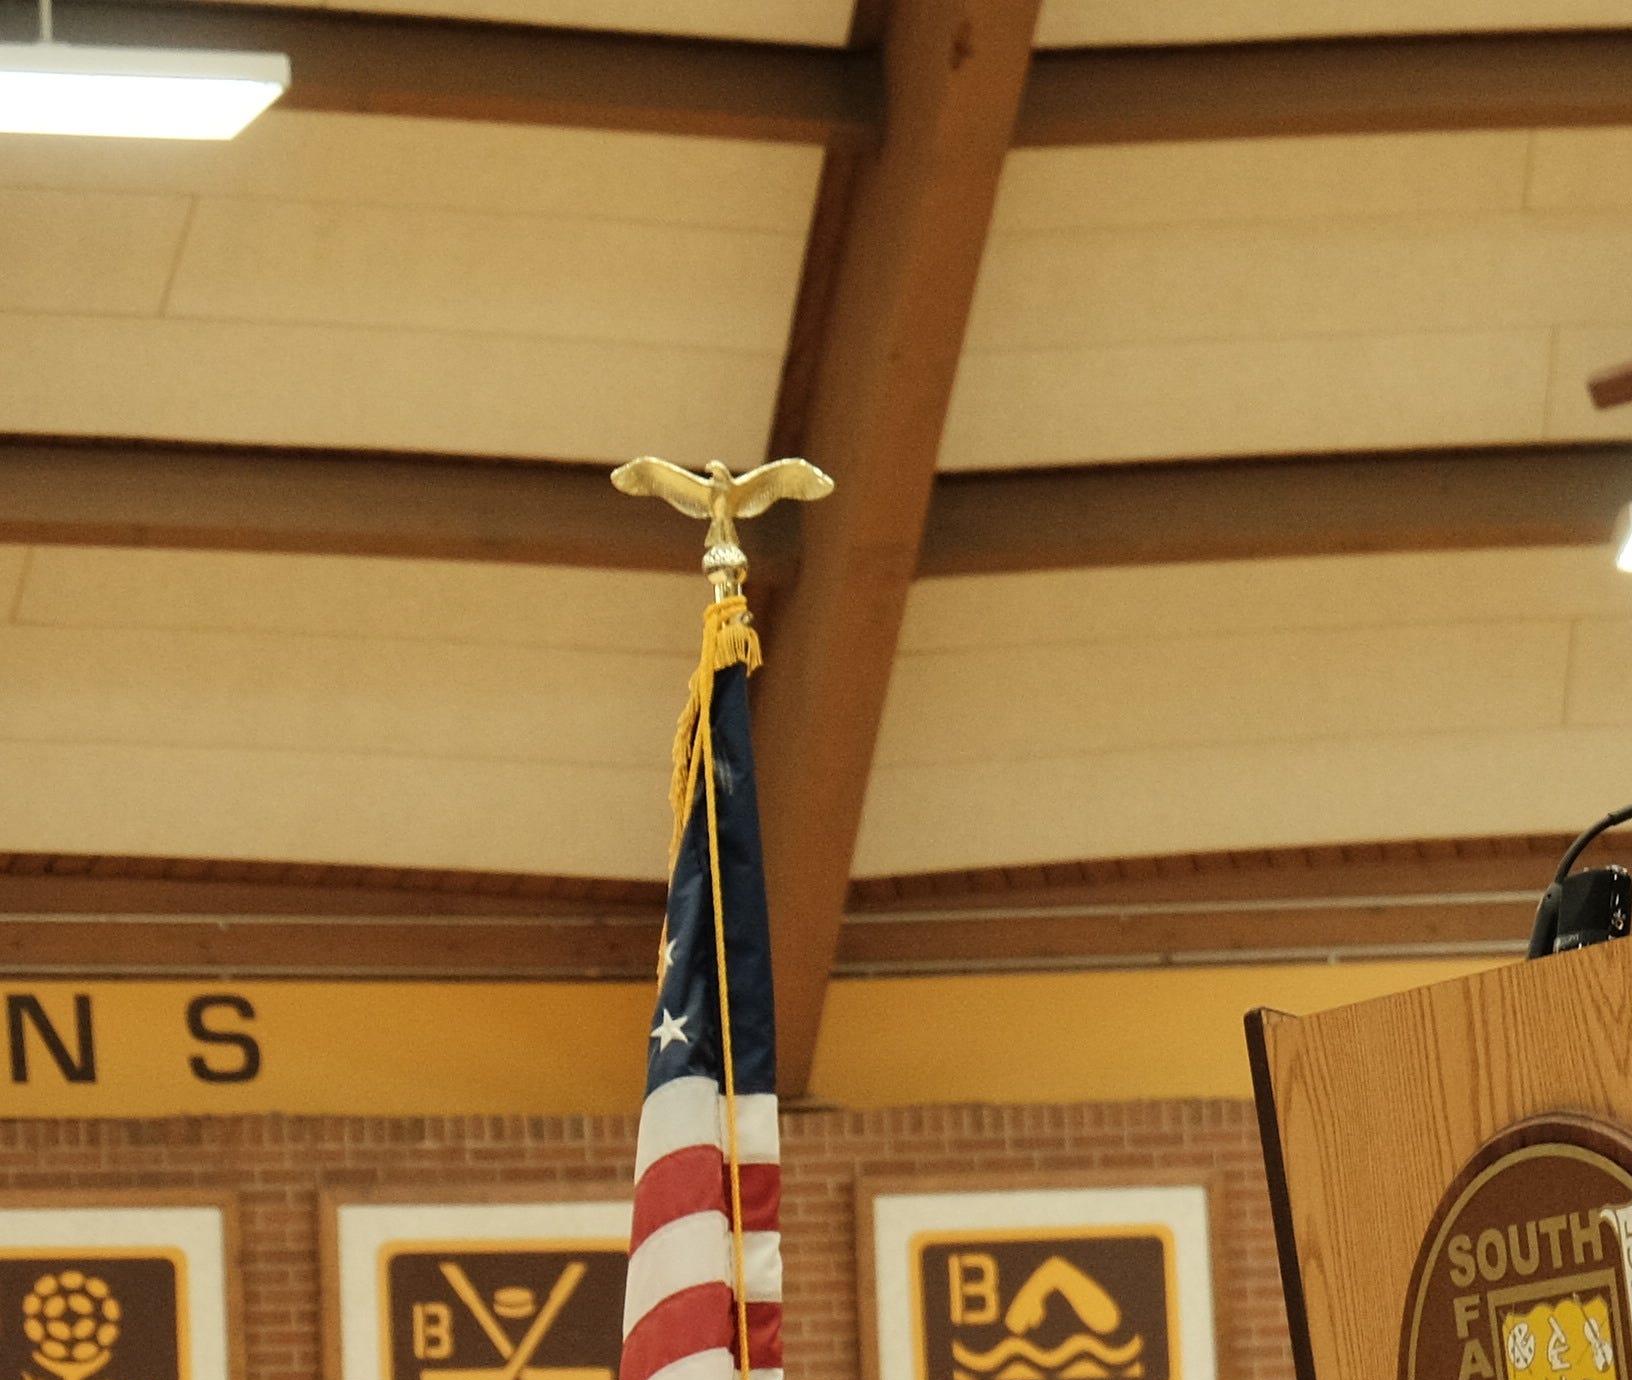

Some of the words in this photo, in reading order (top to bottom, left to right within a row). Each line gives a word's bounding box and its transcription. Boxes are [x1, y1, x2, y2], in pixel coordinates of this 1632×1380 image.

[1448, 1208, 1604, 1288] SOUTH
[947, 1254, 999, 1324] B
[413, 1303, 454, 1359] B
